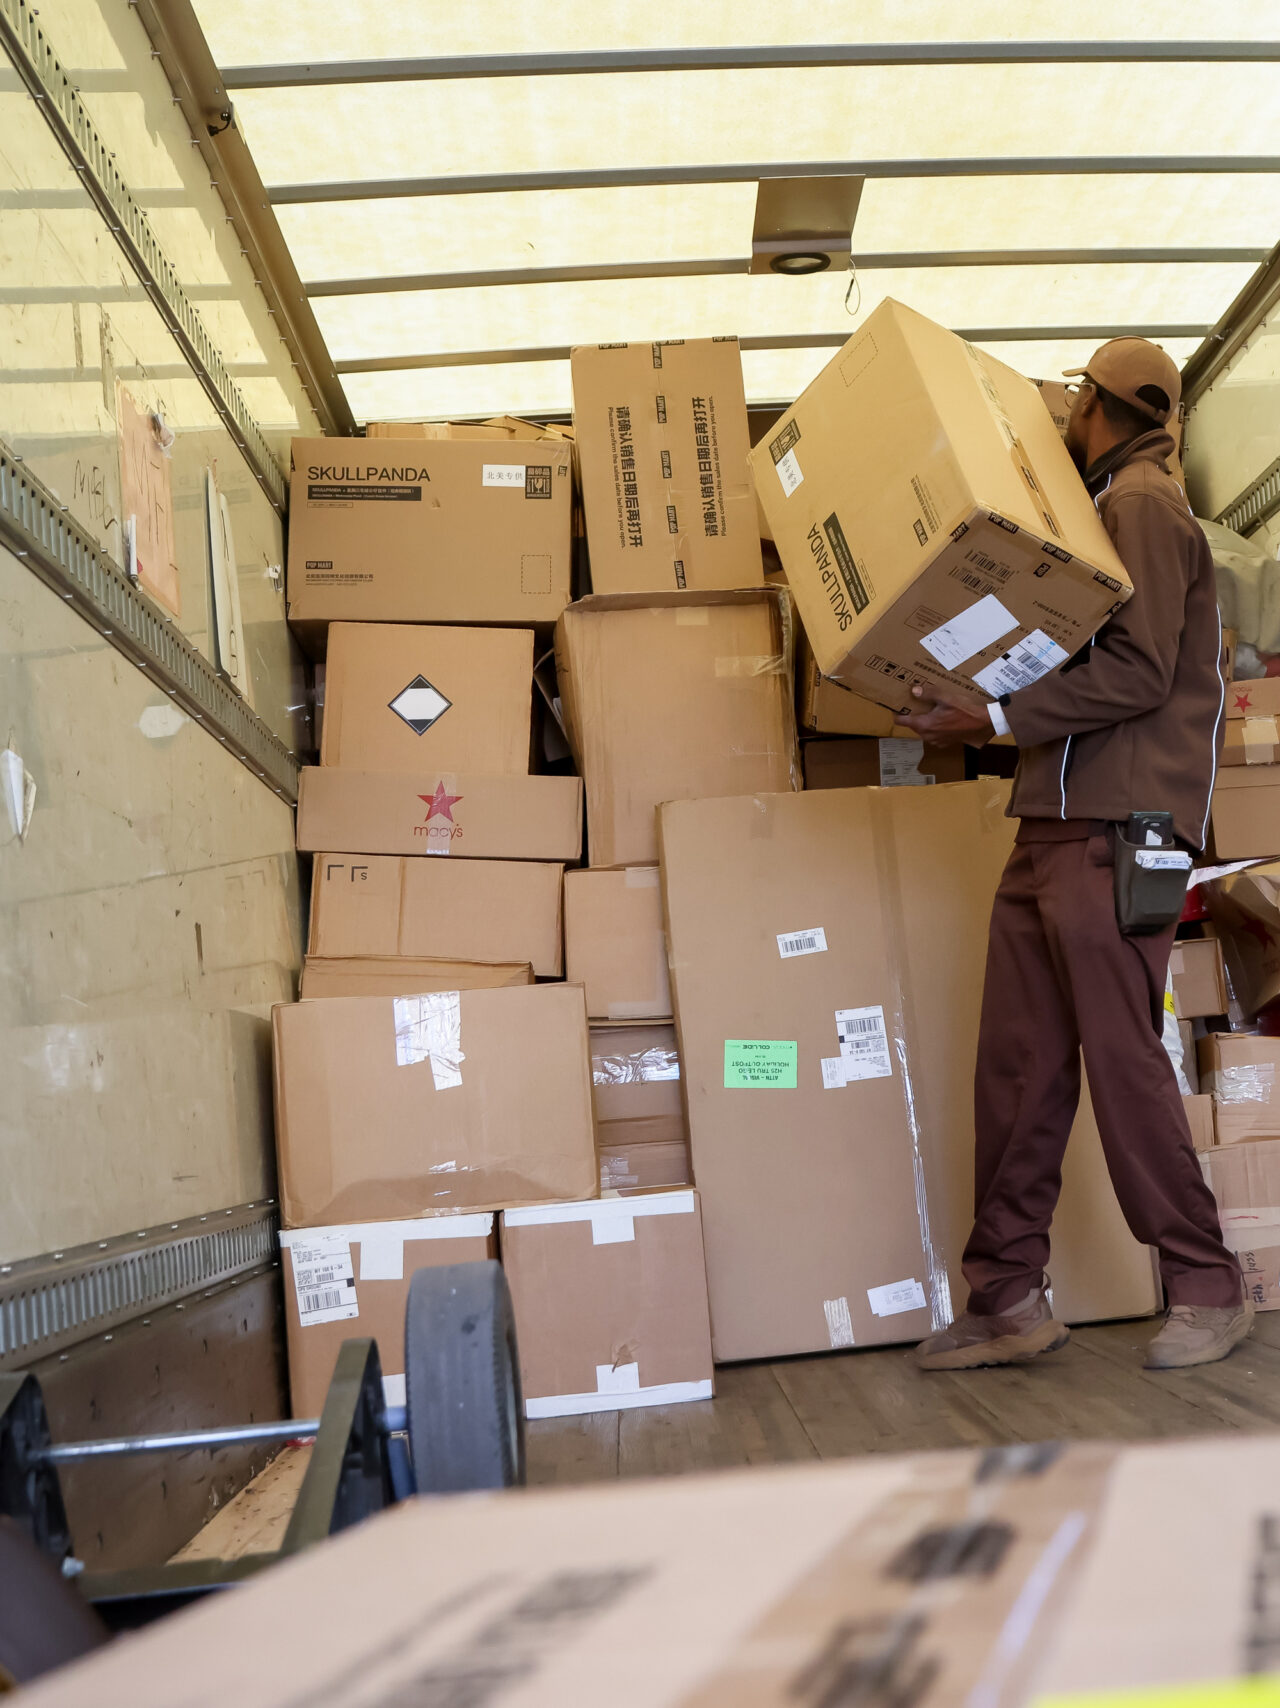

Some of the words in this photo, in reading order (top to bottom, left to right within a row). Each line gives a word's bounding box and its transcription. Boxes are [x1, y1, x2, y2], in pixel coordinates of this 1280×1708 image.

[308, 466, 431, 482] SKULLPANDA
[692, 395, 719, 538] 请确认销售日期后再打开
[615, 406, 643, 548] 请确认销售日期后再打开
[807, 522, 853, 632] SKULLPANDA
[1105, 578, 1122, 592] MART
[413, 824, 463, 840] macy's
[361, 872, 368, 880] S
